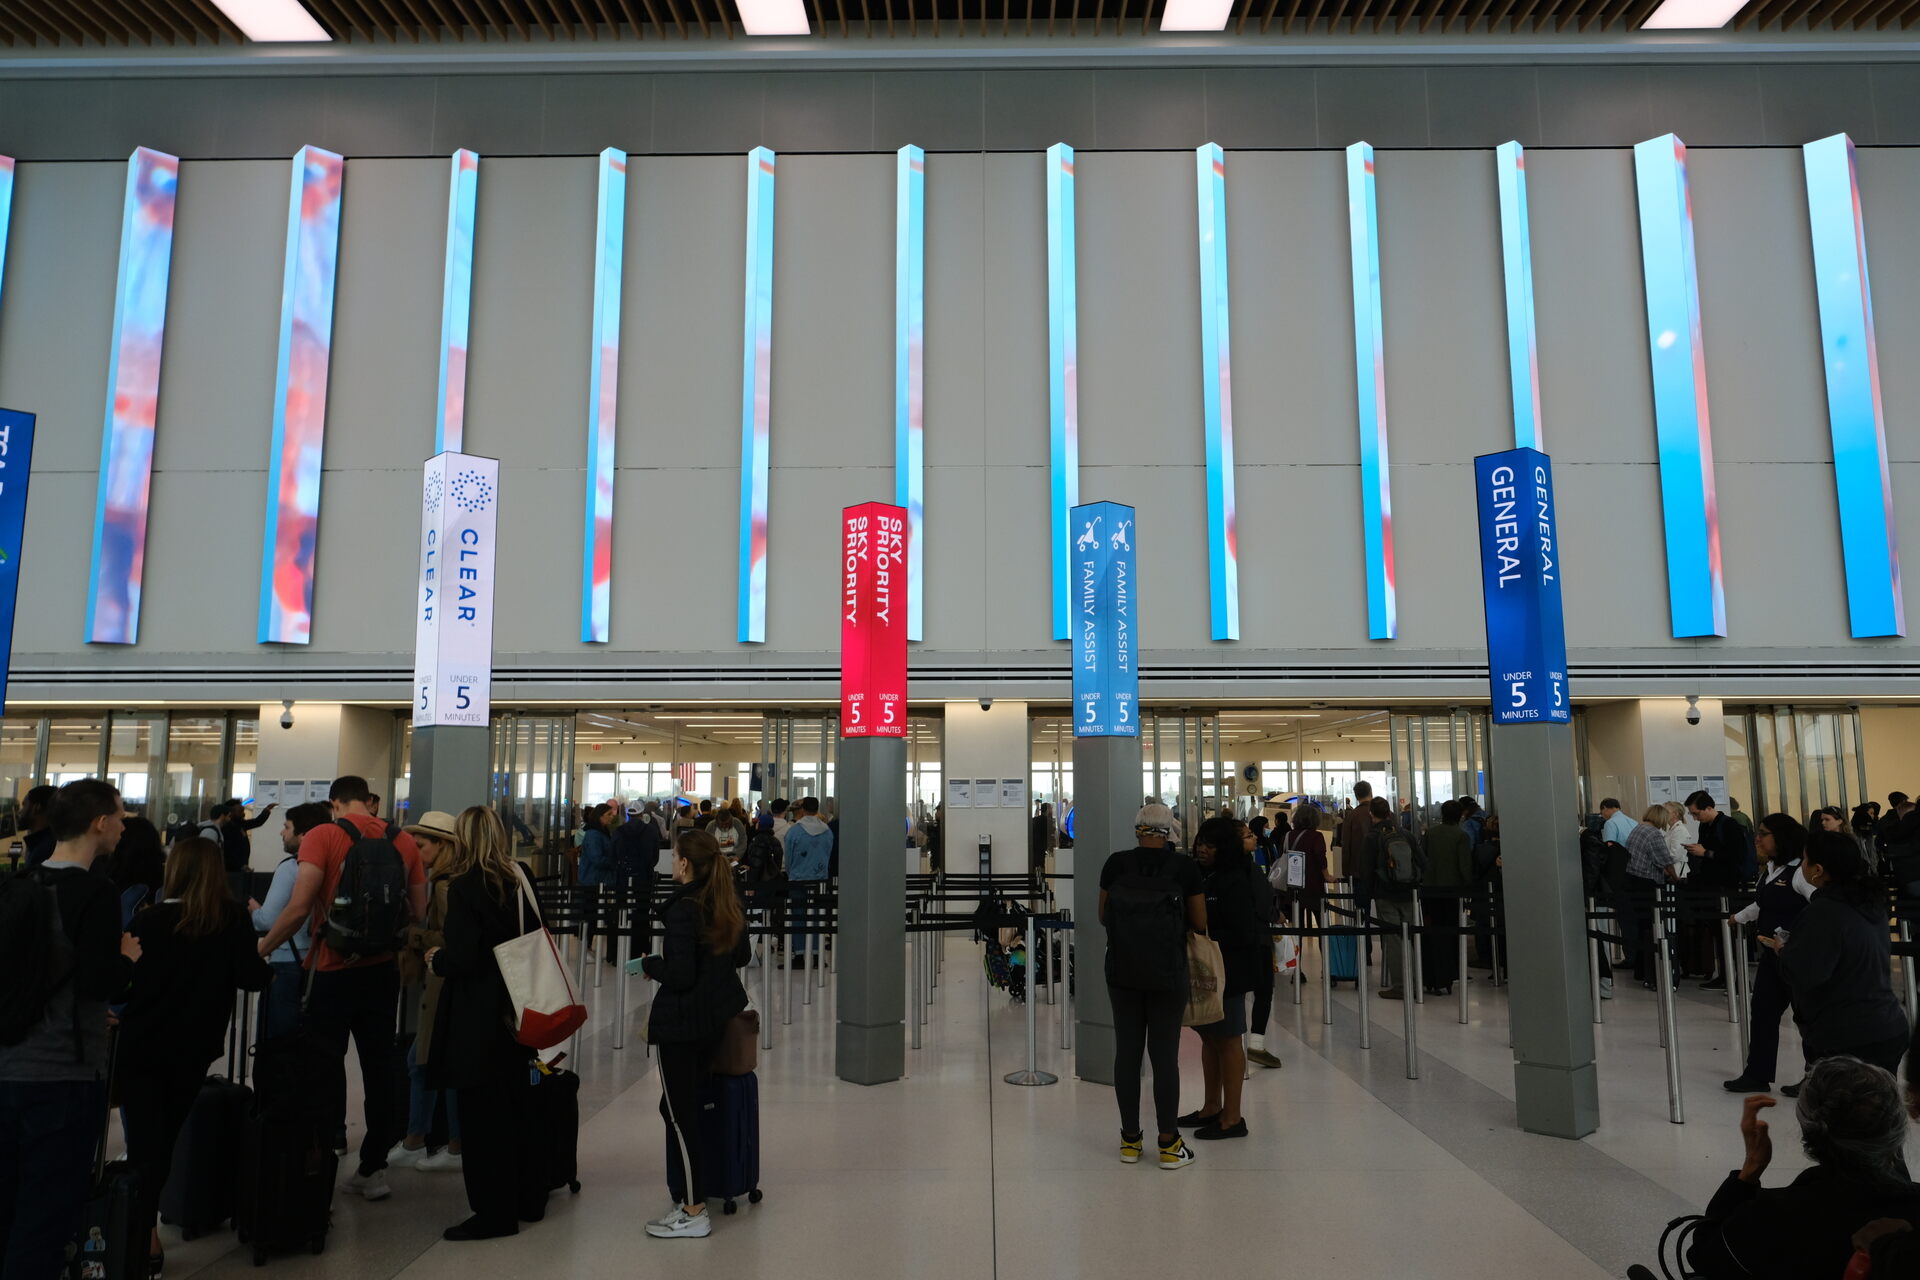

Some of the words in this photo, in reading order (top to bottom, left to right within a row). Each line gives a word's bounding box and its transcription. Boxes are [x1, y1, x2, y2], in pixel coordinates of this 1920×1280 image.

[1491, 466, 1521, 588] GENERAL
[1535, 466, 1554, 586] GENERAL
[857, 516, 868, 561] SKY
[890, 518, 903, 565] SKY
[424, 529, 436, 622] CLEAR
[458, 529, 479, 622] CLEAR
[846, 518, 857, 624] PRIORITY
[876, 515, 889, 624] PRIORITY
[1083, 561, 1095, 616] FAMILY
[1116, 561, 1127, 617] FAMILY
[1084, 620, 1096, 673] ASSIST
[1117, 620, 1128, 673] ASSIST
[449, 675, 478, 684] UNDER
[1503, 671, 1532, 681] UNDER
[1549, 671, 1563, 681] UNDER
[421, 686, 428, 710] 5
[456, 685, 470, 710] 5
[847, 693, 864, 702] UNDER
[878, 693, 899, 702] UNDER
[1080, 692, 1101, 701] UNDER
[1115, 692, 1132, 701] UNDER
[1511, 681, 1527, 707] 5
[1553, 681, 1562, 707] 5
[444, 713, 480, 722] MINUTES
[851, 702, 860, 724] 5
[883, 702, 894, 723] 5
[1085, 701, 1096, 723] 5
[1119, 701, 1129, 723] 5
[1501, 709, 1539, 720] MINUTES
[1550, 709, 1568, 719] MINUTES
[845, 726, 866, 734] MINUTES
[876, 725, 901, 734] MINUTES
[1078, 725, 1104, 733] MINUTES
[1113, 725, 1135, 733] MINUTES
